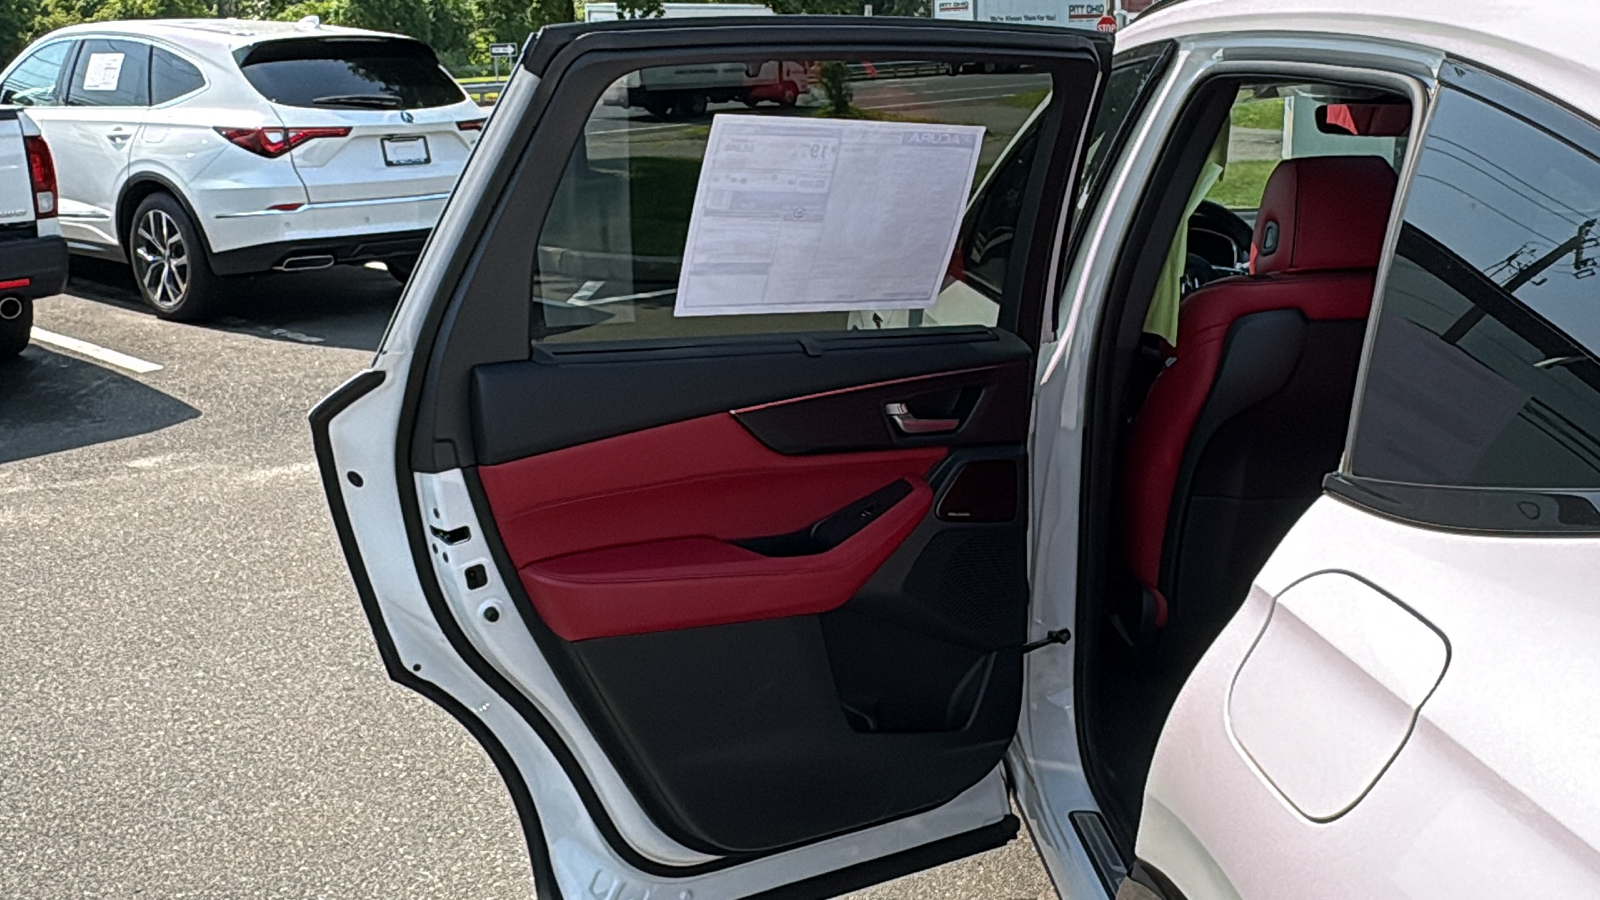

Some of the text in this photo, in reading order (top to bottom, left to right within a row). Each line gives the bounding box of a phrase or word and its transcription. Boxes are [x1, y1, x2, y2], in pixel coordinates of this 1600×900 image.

[1068, 4, 1104, 14] PITT OHIO
[1097, 23, 1116, 32] STOP
